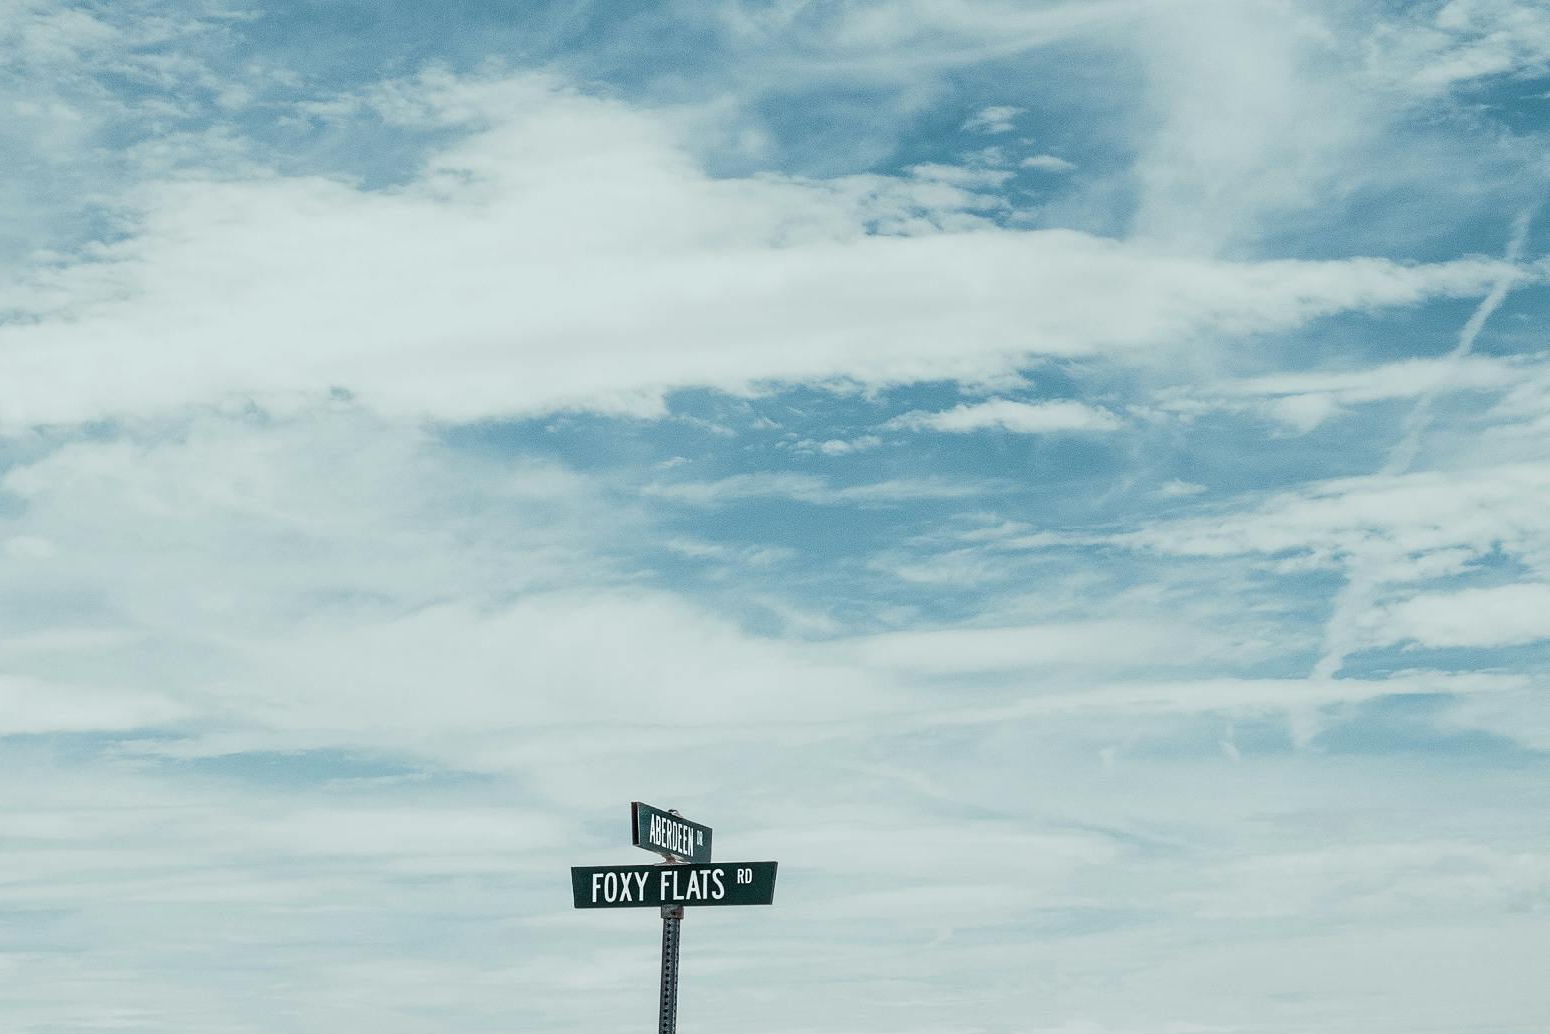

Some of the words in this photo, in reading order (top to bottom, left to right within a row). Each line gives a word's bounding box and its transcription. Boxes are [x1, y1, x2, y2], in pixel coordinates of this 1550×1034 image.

[650, 813, 694, 857] ABERDEEN
[696, 829, 704, 848] DR
[591, 871, 649, 903] FOXY
[660, 868, 725, 901] FLATS
[737, 868, 753, 884] RD
